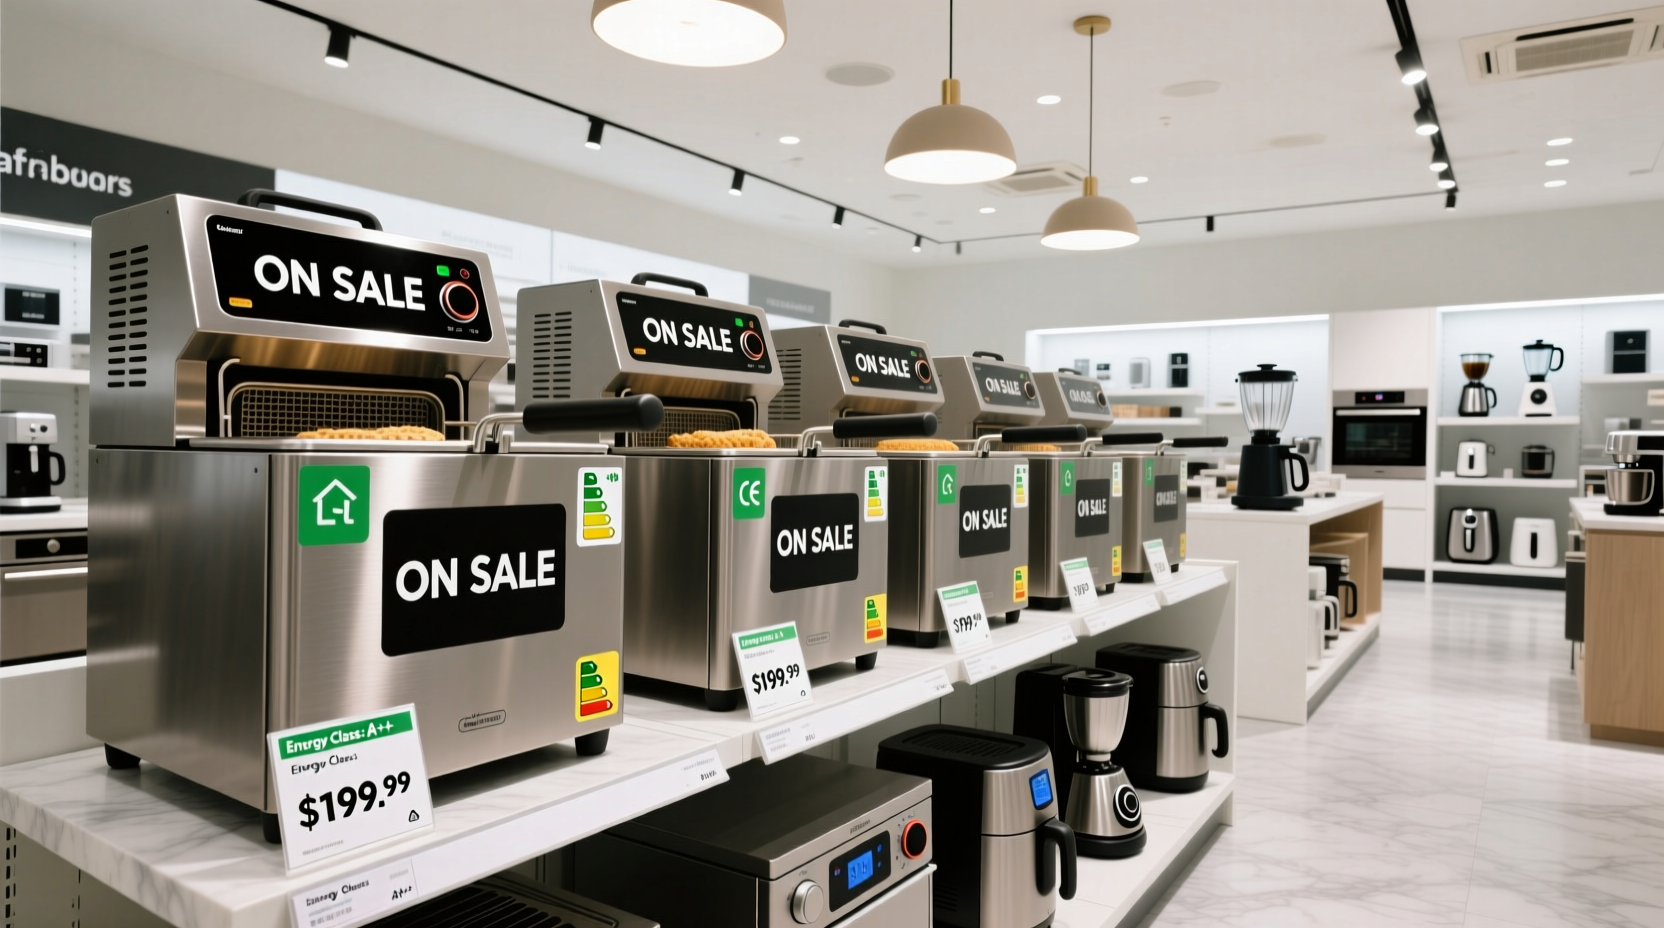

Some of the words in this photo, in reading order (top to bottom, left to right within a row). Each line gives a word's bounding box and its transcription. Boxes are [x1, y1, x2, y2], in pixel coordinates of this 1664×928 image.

[254, 254, 321, 296] ON
[333, 265, 425, 311] SALE
[642, 317, 679, 346] ON
[682, 321, 734, 353] SALE
[855, 352, 878, 374] ON
[878, 356, 911, 378] SALE
[962, 510, 980, 532] ON
[982, 507, 1008, 530] SALE
[777, 528, 807, 557] ON
[811, 524, 854, 554] SALE
[396, 557, 459, 602] ON
[470, 549, 556, 594] SALE
[751, 662, 801, 696] $199.99
[367, 720, 394, 738] A++
[298, 770, 412, 832] $199.99
